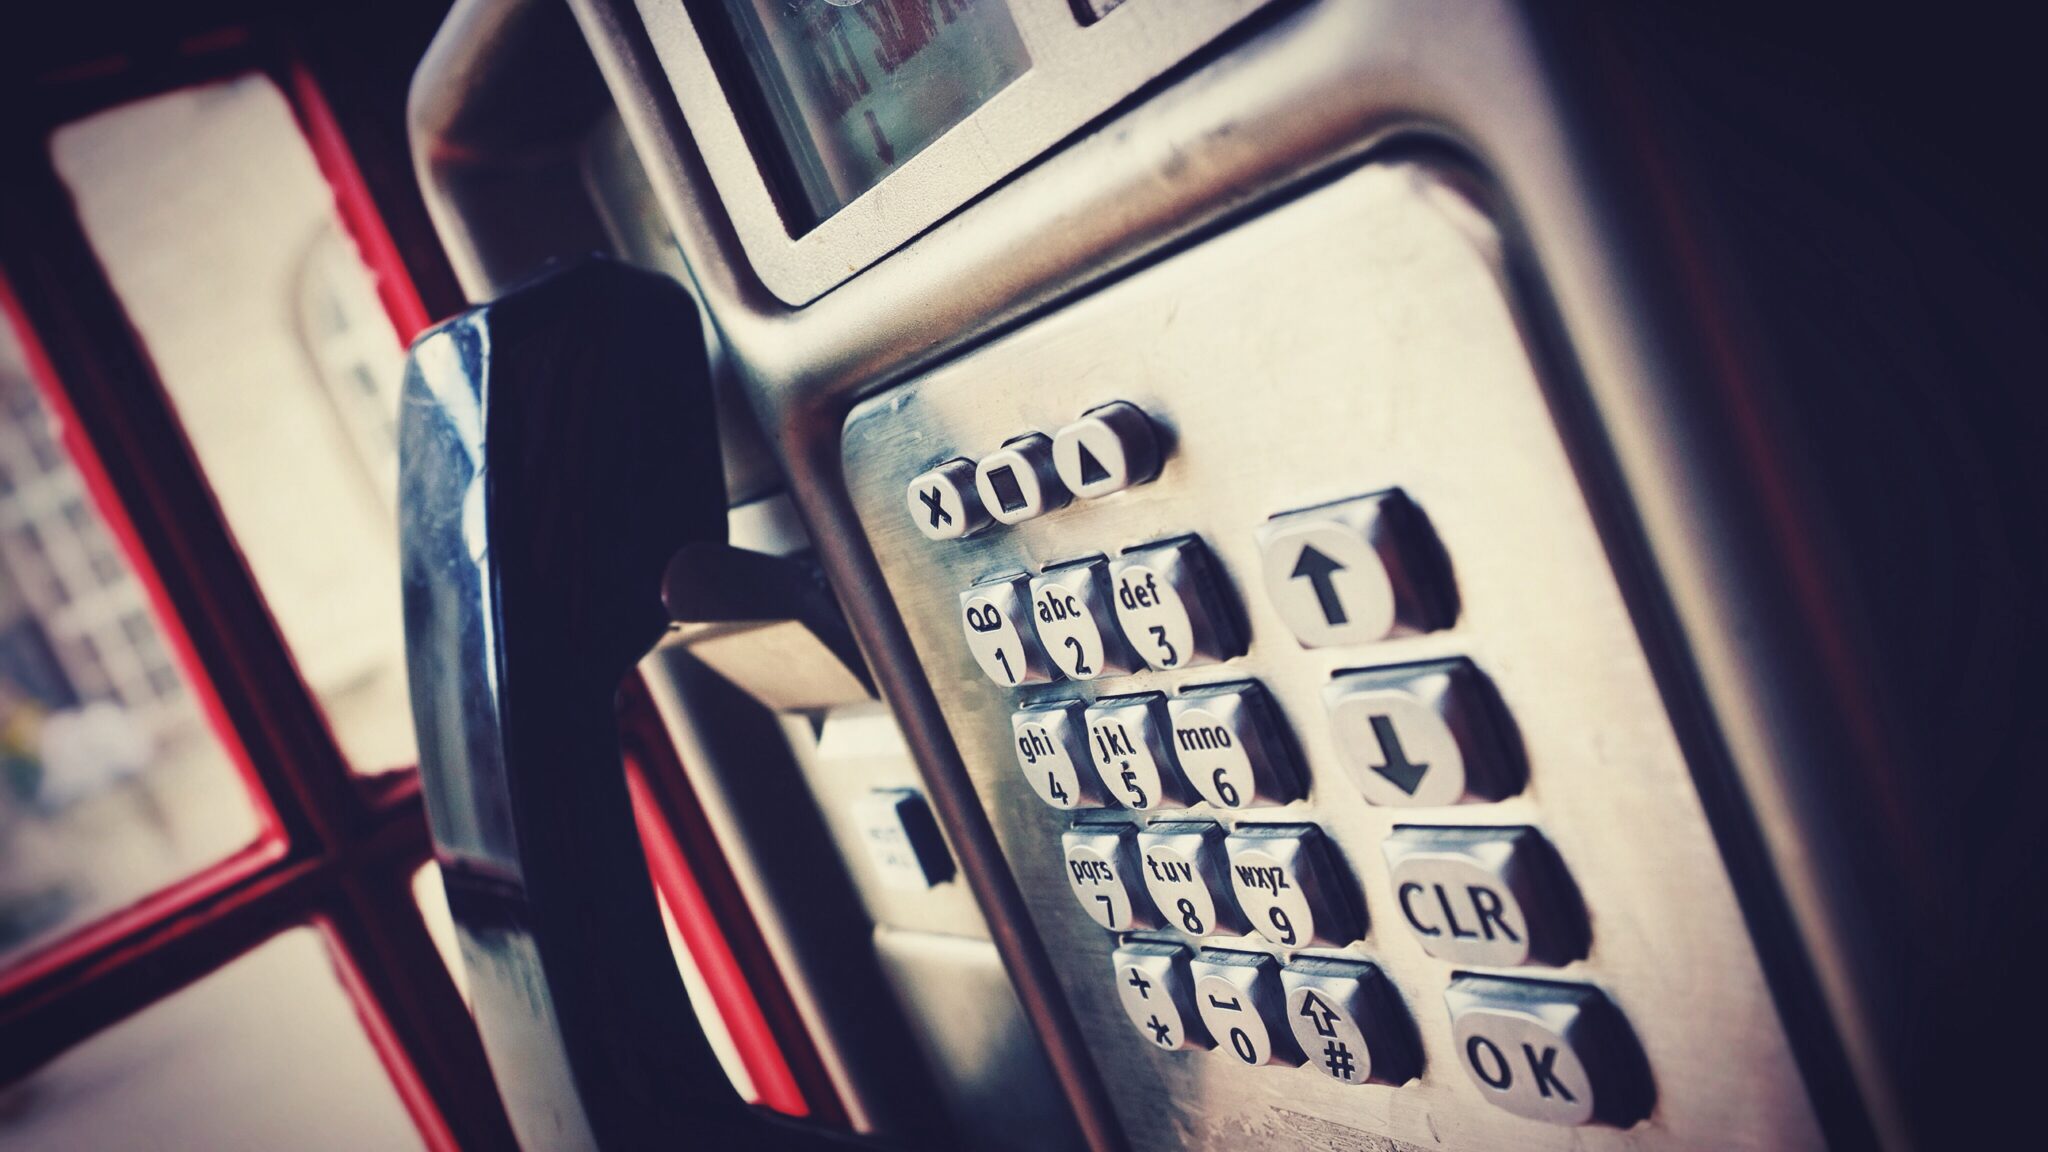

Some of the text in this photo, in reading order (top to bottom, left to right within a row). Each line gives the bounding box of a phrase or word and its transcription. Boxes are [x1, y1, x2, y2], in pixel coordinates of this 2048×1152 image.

[1037, 591, 1081, 623] abc
[1119, 573, 1160, 610] def
[1065, 637, 1091, 676] 2
[1149, 626, 1178, 666] 3
[995, 648, 1016, 684] 1
[1019, 728, 1055, 764] ghi
[1094, 724, 1136, 764] jkl
[1177, 725, 1231, 751] mno
[1049, 772, 1068, 804] 4
[1121, 771, 1147, 808] 5
[1213, 768, 1240, 807] 6
[1069, 859, 1113, 885] pqrs
[1147, 855, 1191, 883] tuv
[1235, 864, 1290, 896] wxyz
[1096, 896, 1115, 928] 7
[1177, 898, 1203, 935] 8
[1269, 907, 1296, 945] 9
[1399, 882, 1520, 943] CLR
